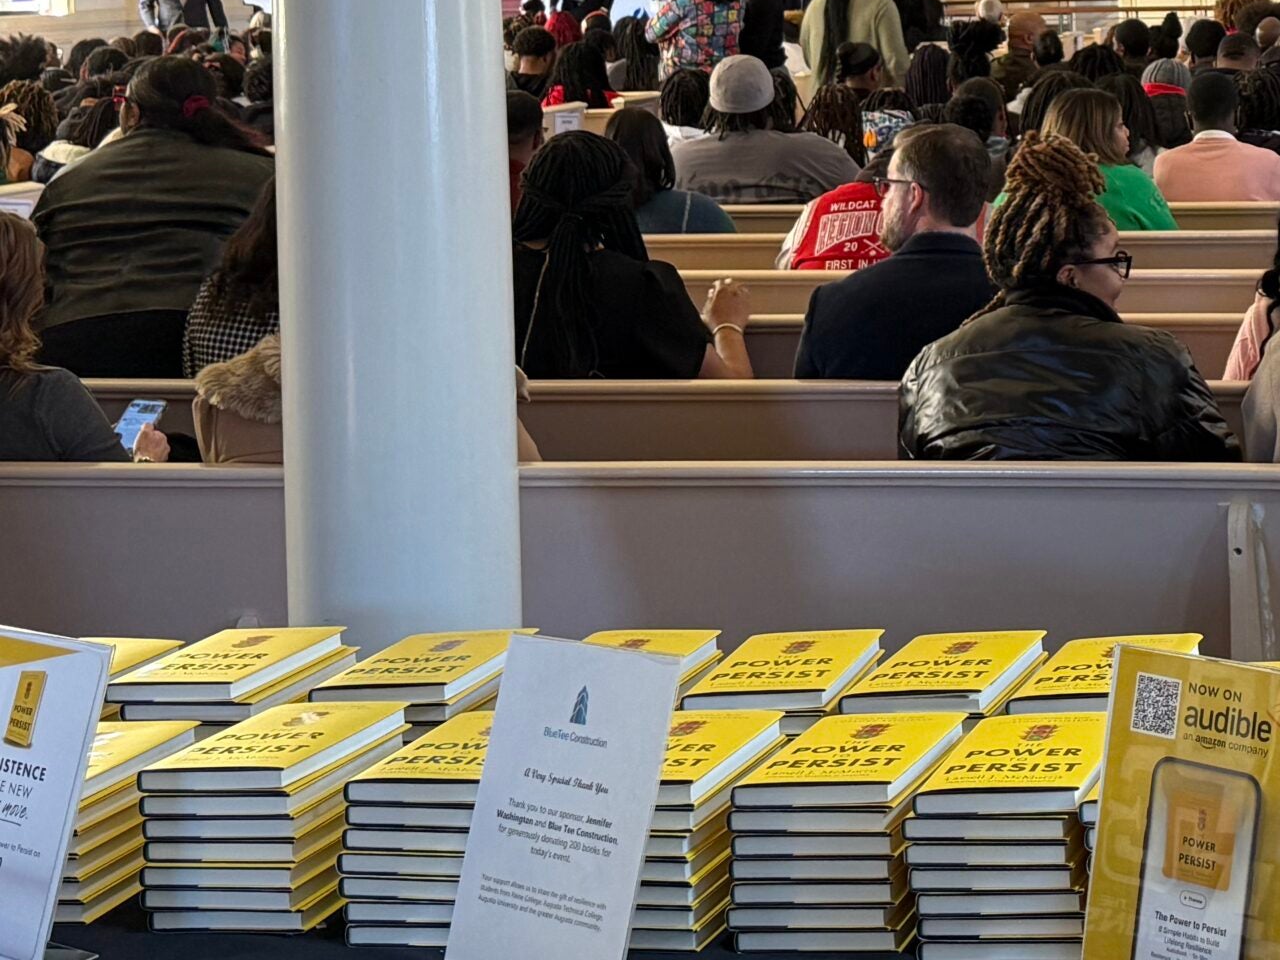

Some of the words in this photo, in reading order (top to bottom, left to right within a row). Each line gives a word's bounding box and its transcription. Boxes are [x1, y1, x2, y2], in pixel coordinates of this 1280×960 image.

[830, 200, 877, 212] WILDCAT
[815, 210, 877, 257] REGION
[843, 242, 858, 252] 20
[826, 259, 855, 270] FIRST
[372, 655, 472, 664] POWER
[730, 657, 834, 668] POWER
[890, 658, 992, 669] POWER
[344, 665, 463, 676] PERSIST
[1052, 663, 1113, 673] POW
[709, 669, 832, 682] PERSIST
[872, 670, 991, 681] PERSIST
[1034, 674, 1112, 685] PERS
[1188, 682, 1220, 698] NOW
[1223, 689, 1243, 703] ON
[10, 718, 32, 732] PERSIST
[1184, 706, 1273, 743] audible
[217, 731, 326, 742] POWER
[190, 744, 311, 756] PERSIST
[414, 742, 489, 751] POW
[791, 744, 906, 755] POWER
[1183, 732, 1194, 742] an
[1194, 734, 1227, 750] amazon
[1228, 742, 1270, 759] company
[965, 748, 1083, 759] POWER
[766, 758, 902, 770] PERSIST
[944, 762, 1083, 775] PERSIST
[532, 769, 547, 783] Very
[548, 772, 572, 787] Special
[572, 776, 594, 793] Thank
[594, 782, 609, 797] You
[8, 782, 34, 799] NEW
[508, 796, 527, 810] Thank
[527, 801, 539, 814] you
[539, 804, 547, 814] to
[548, 808, 559, 818] our
[586, 814, 613, 830] Jennifer
[496, 808, 534, 827] Washington
[534, 818, 547, 829] and
[548, 820, 563, 832] Blue
[498, 824, 508, 834] for
[507, 826, 540, 844] generously
[541, 833, 569, 850] donating
[582, 844, 601, 856] books
[601, 848, 612, 859] for
[1182, 836, 1217, 853] POWER
[17, 843, 33, 856] Persist
[530, 846, 553, 861] today's
[1178, 852, 1217, 871] PERSIST
[1155, 910, 1169, 922] The
[1170, 914, 1192, 929] Power
[1192, 921, 1201, 930] to
[1201, 923, 1227, 938] Persist
[1164, 937, 1185, 950] Lifelong
[1186, 940, 1213, 955] Resilience
